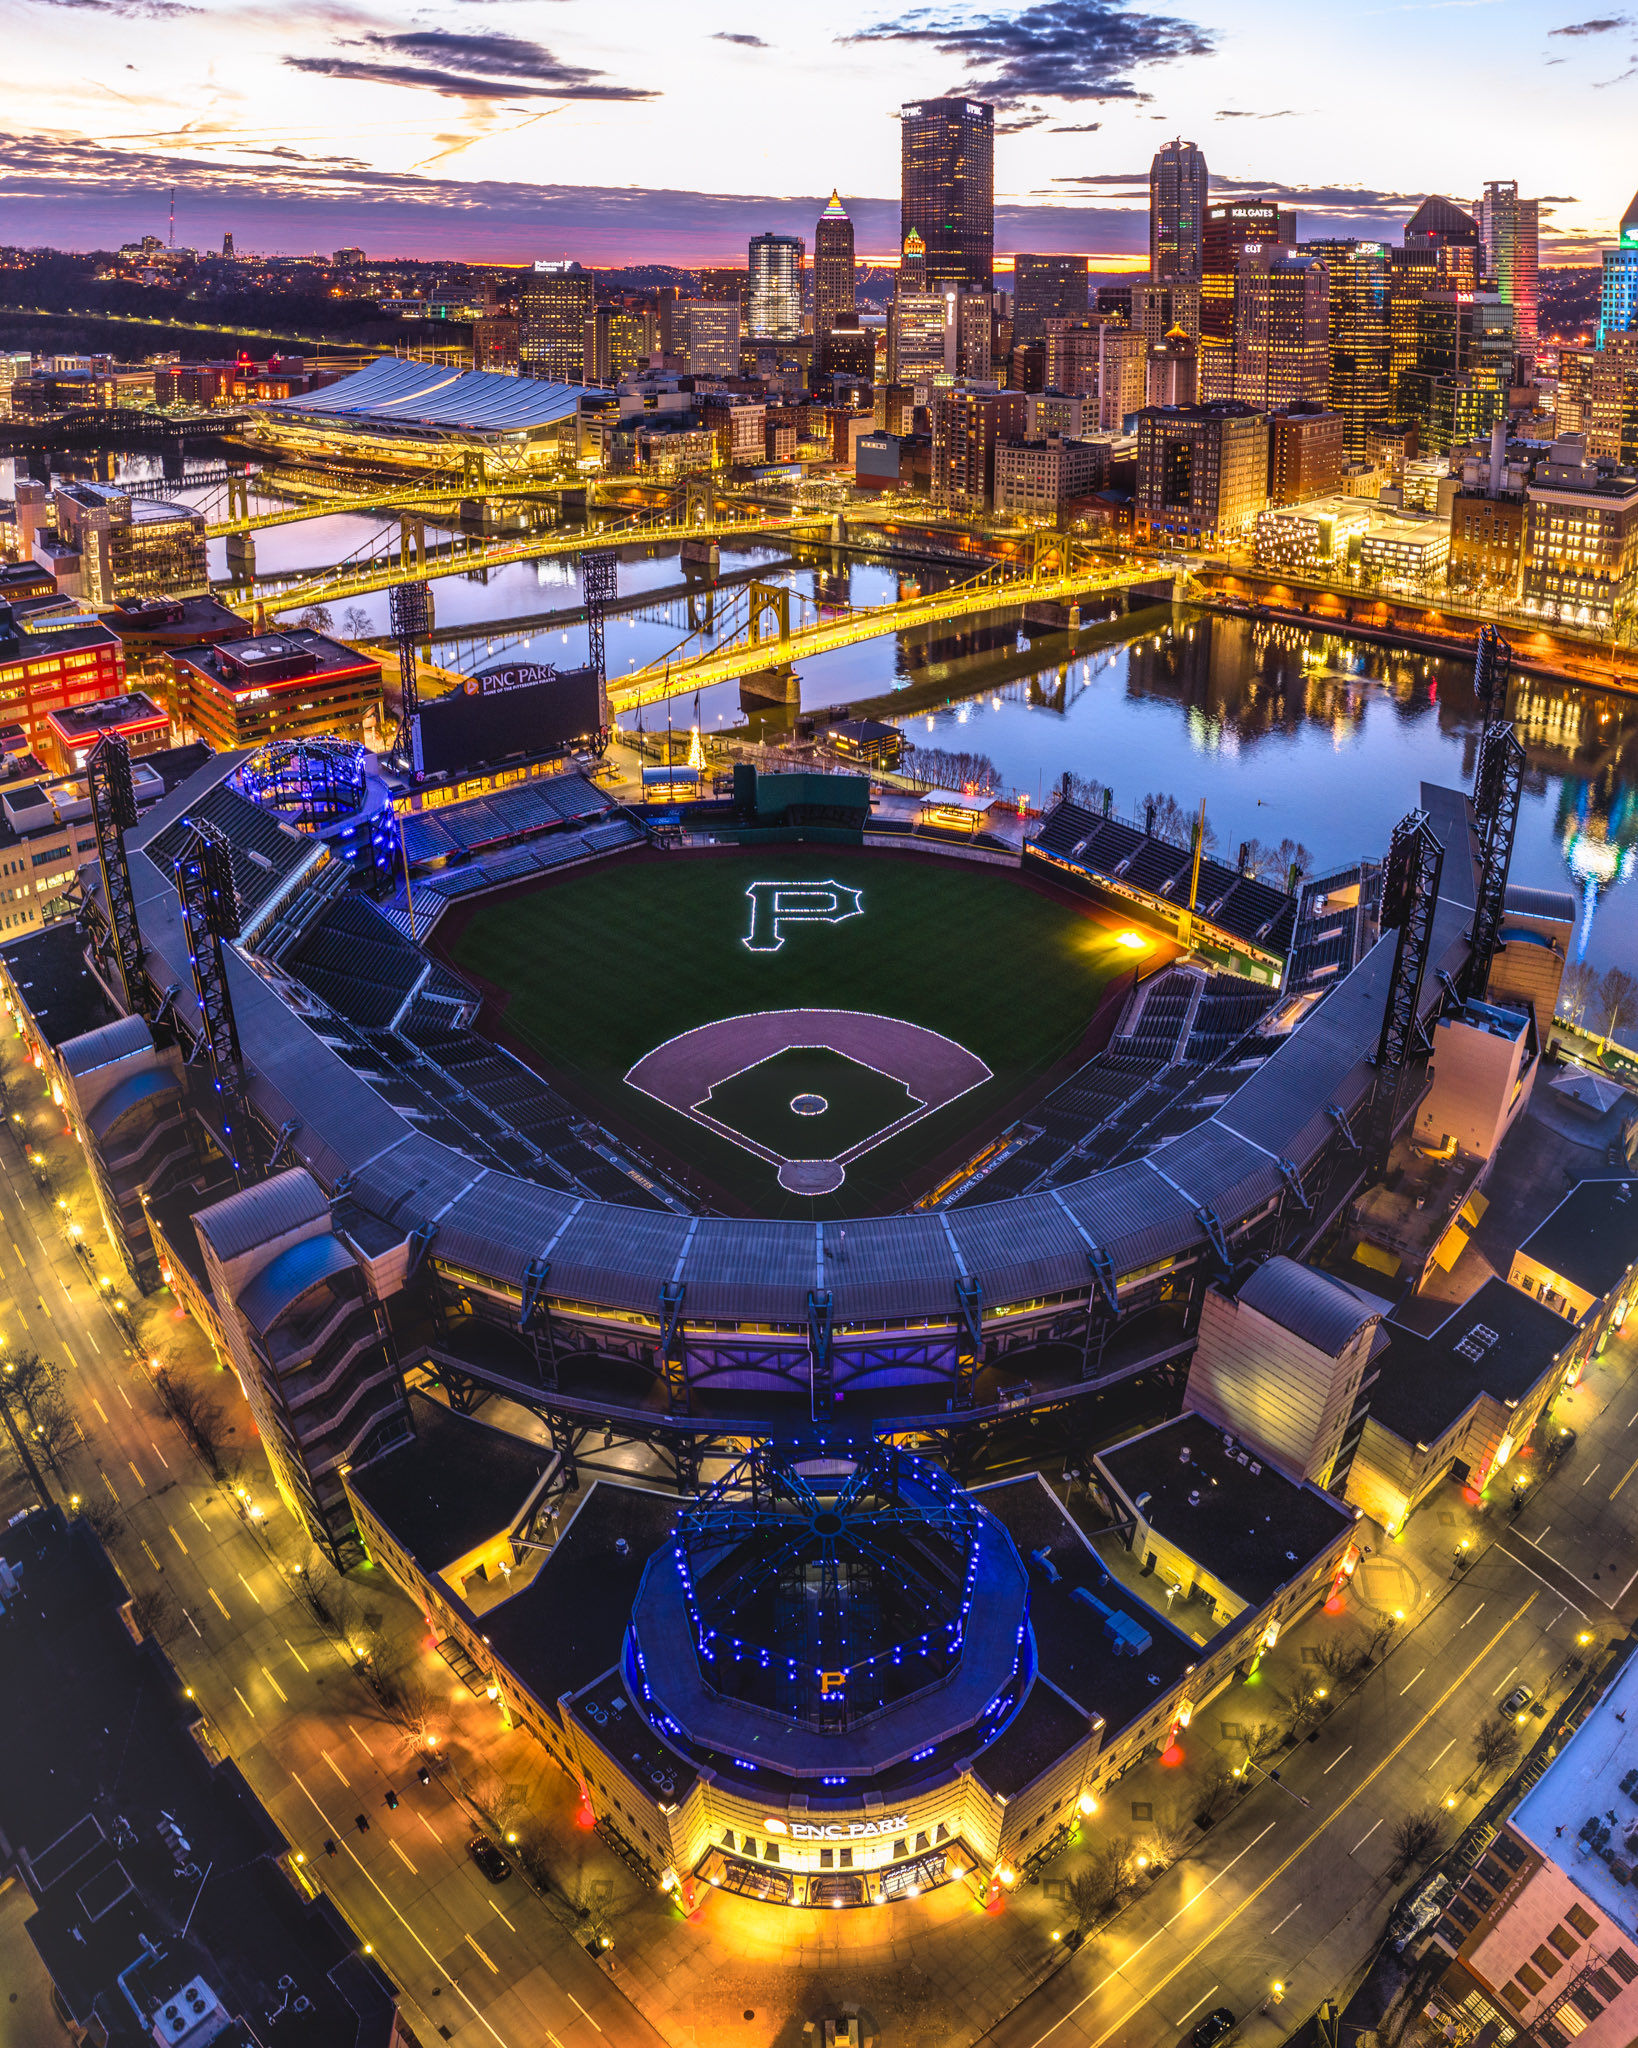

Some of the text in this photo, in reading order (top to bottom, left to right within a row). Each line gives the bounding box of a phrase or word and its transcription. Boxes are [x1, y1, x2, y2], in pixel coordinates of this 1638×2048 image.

[1248, 209, 1273, 217] GATES
[1245, 244, 1262, 253] EQT
[481, 662, 556, 691] PNC PARK
[513, 681, 539, 690] PITTSBURGH
[742, 880, 864, 951] P
[627, 1170, 654, 1190] PIRATES
[942, 1179, 976, 1206] WELCOME
[972, 1172, 984, 1183] TO
[820, 1671, 846, 1693] P
[789, 1815, 908, 1839] PNC PARK
